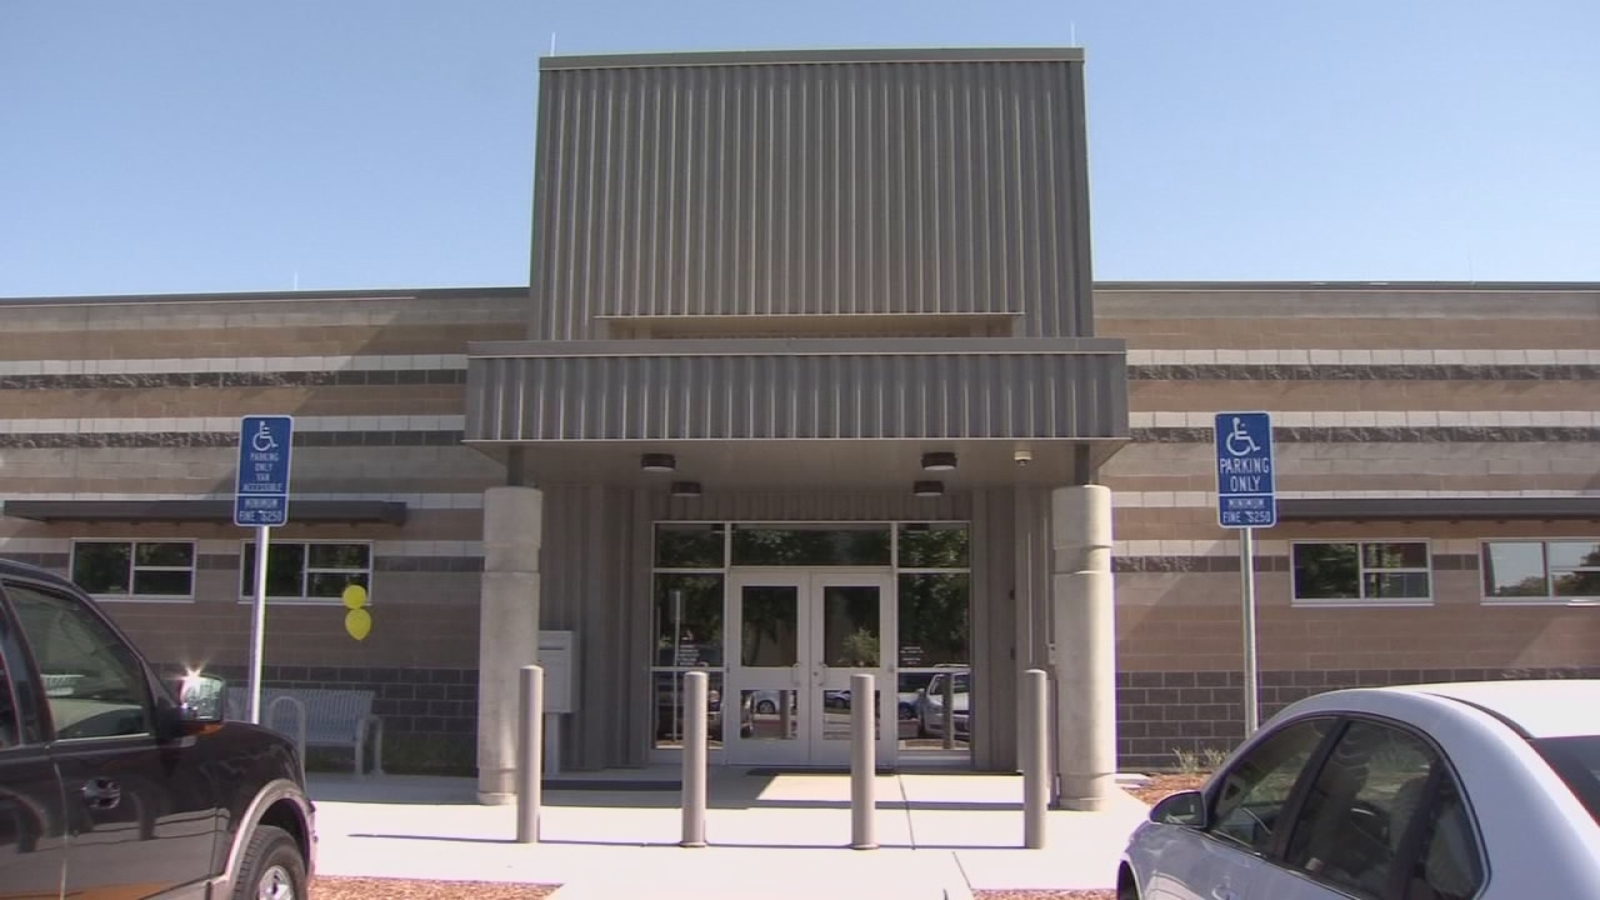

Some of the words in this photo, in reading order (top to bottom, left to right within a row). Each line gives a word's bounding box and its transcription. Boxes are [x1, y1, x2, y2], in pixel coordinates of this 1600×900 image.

[1220, 457, 1270, 474] PARKING
[1230, 475, 1261, 491] ONLY
[1223, 511, 1241, 523] FINE
